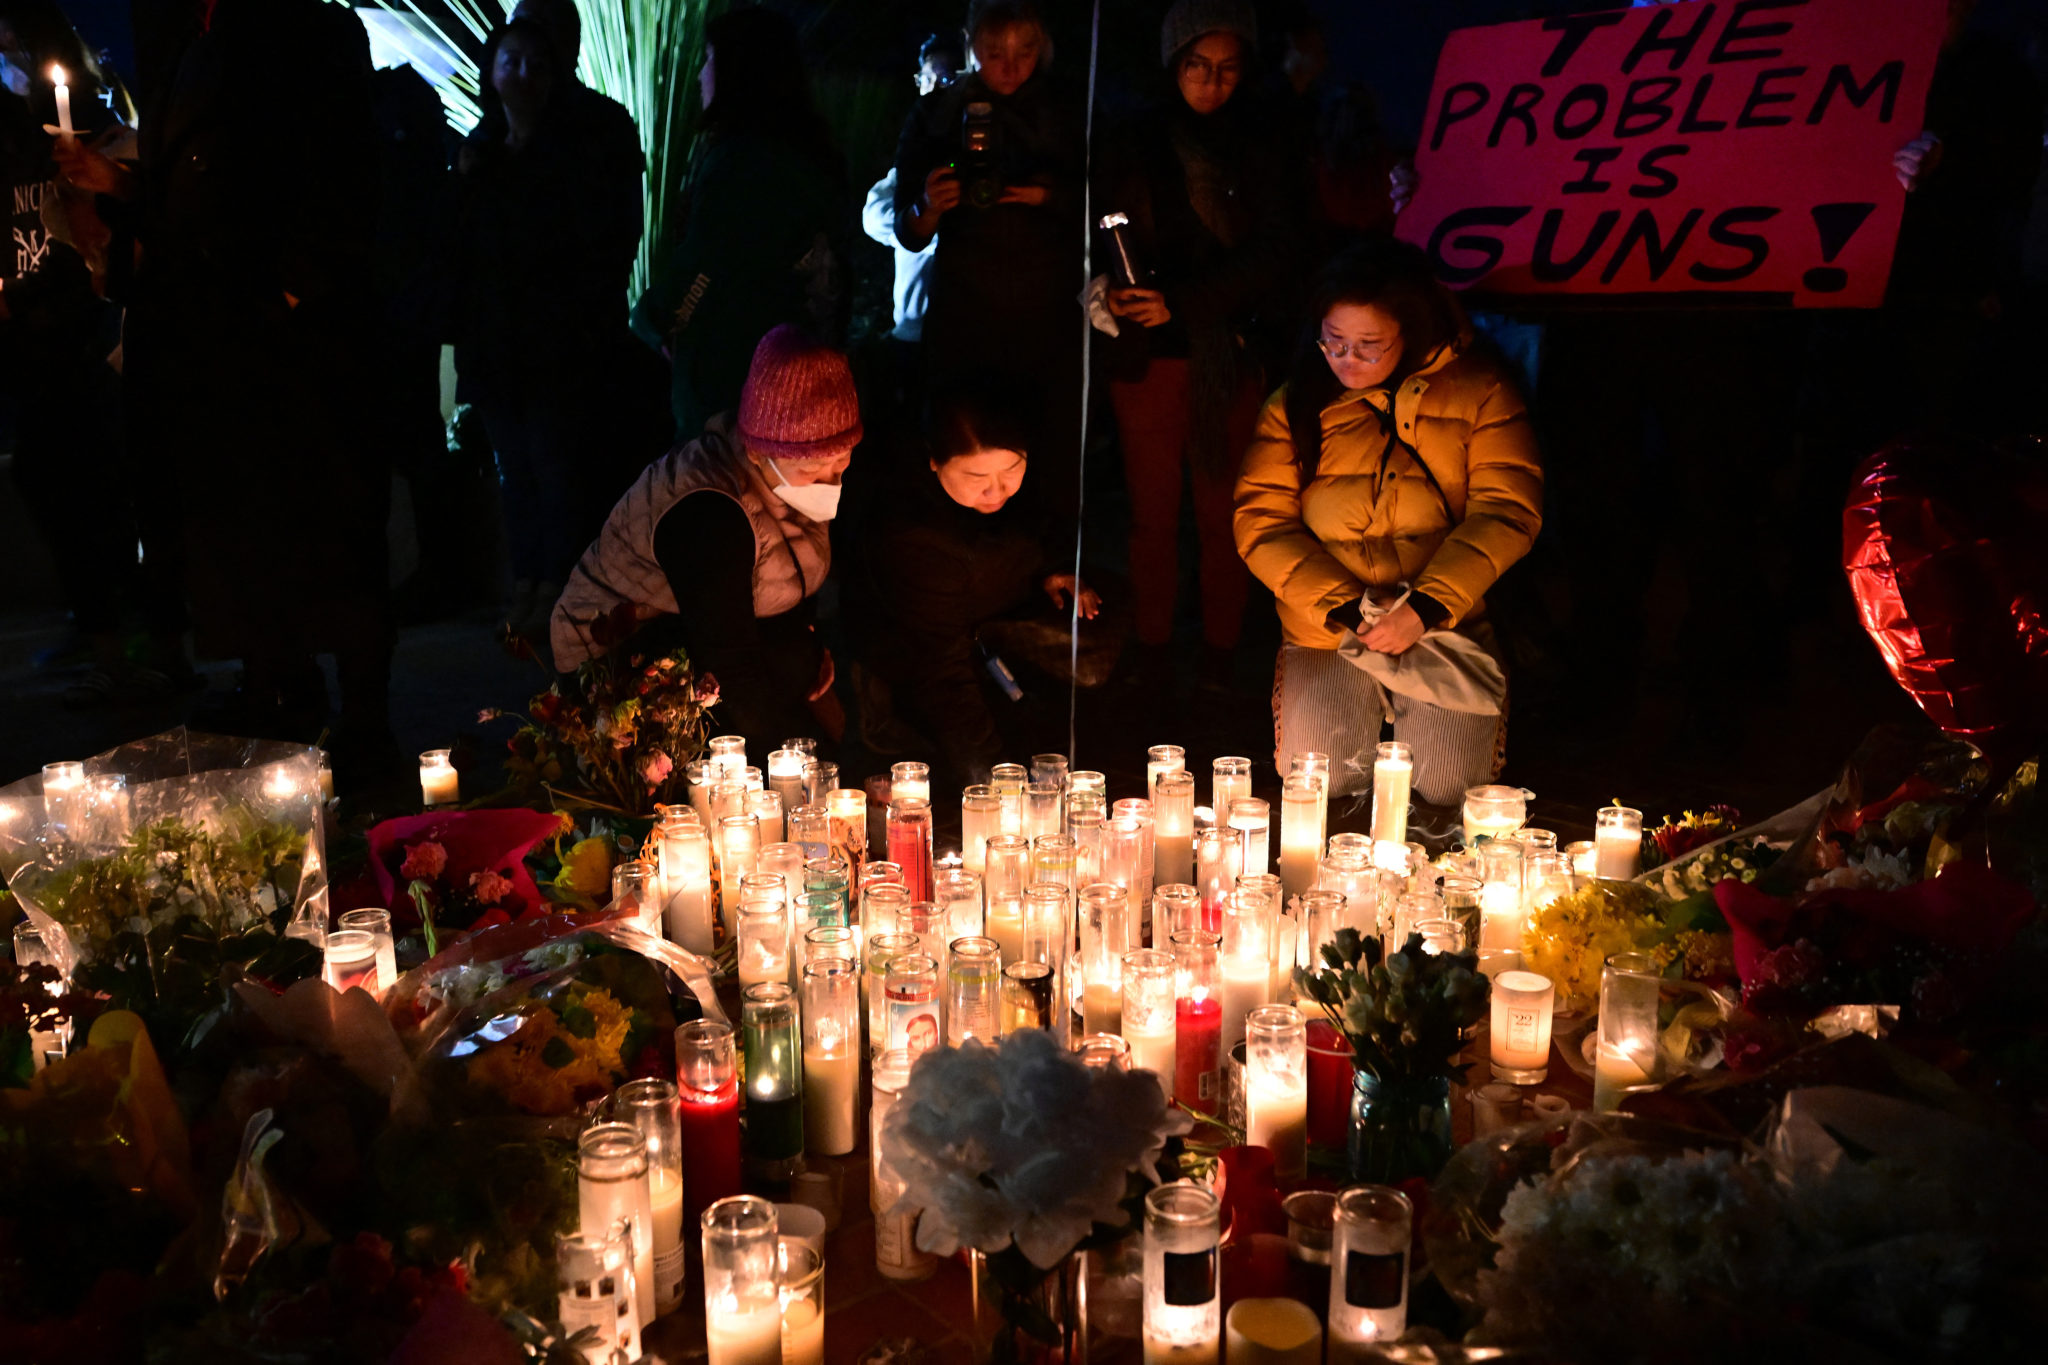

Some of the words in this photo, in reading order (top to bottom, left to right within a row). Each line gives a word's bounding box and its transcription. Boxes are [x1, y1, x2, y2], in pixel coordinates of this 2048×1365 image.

[1541, 0, 1807, 76] THE
[1430, 61, 1904, 151] PROBLEM
[1562, 145, 1690, 198] IS
